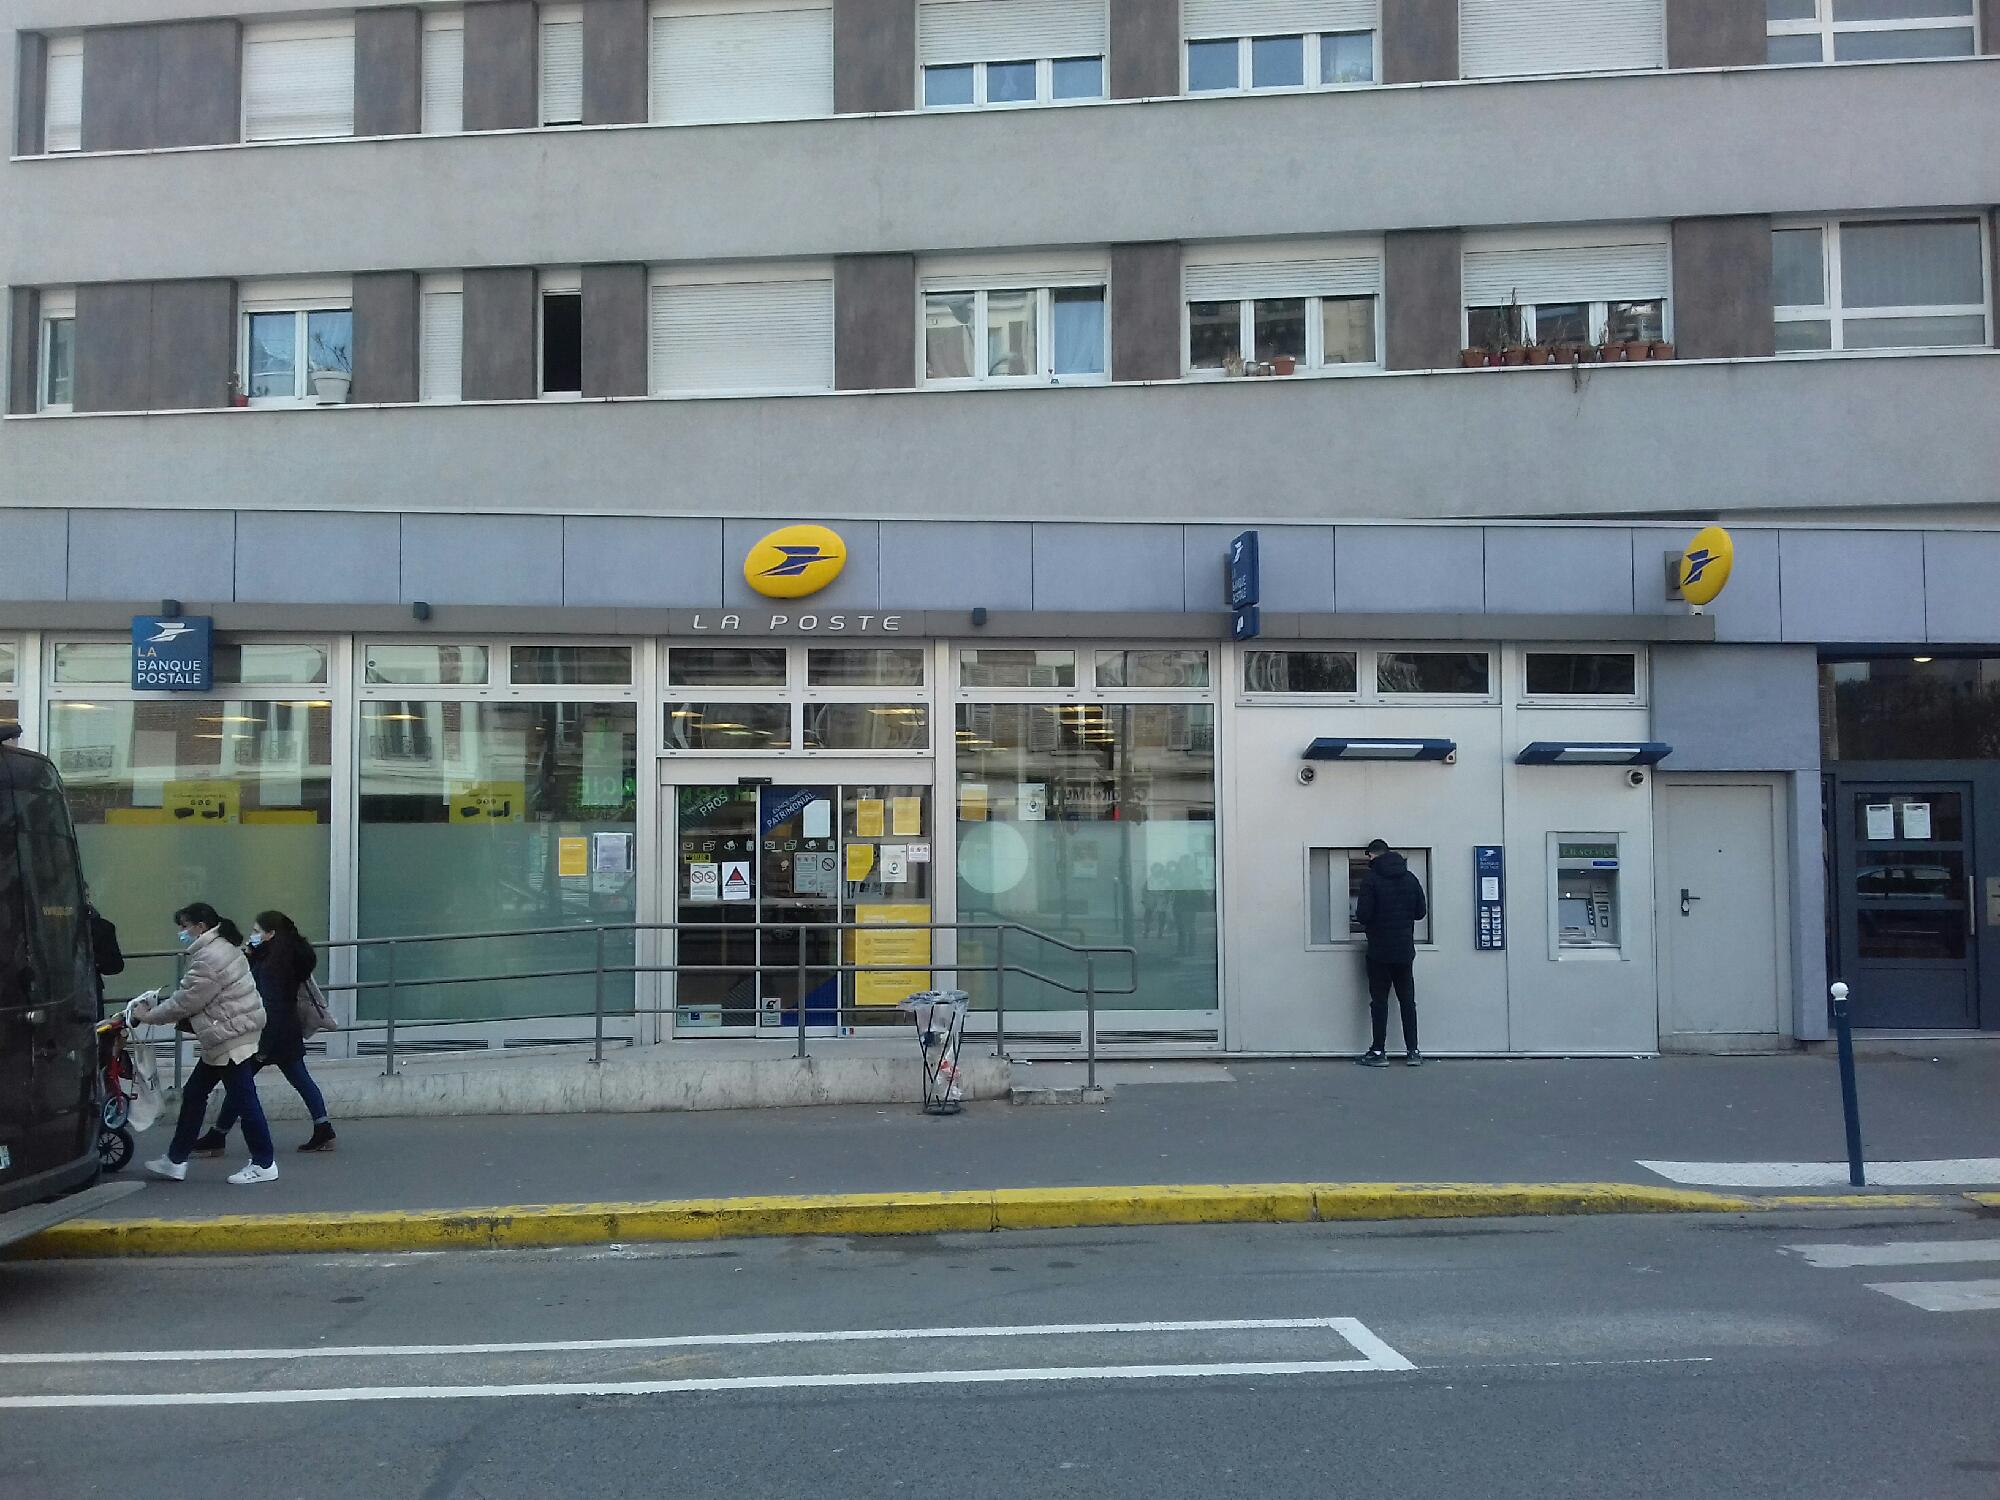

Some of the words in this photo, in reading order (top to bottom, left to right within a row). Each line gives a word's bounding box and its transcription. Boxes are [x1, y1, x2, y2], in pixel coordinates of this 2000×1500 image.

[692, 614, 741, 630] LA
[769, 615, 902, 631] POSTE
[137, 646, 157, 657] LA
[137, 660, 202, 672] BANQUE
[137, 672, 201, 684] POSTALE
[700, 793, 728, 816] PROS
[766, 792, 816, 828] PATRIMONIAL
